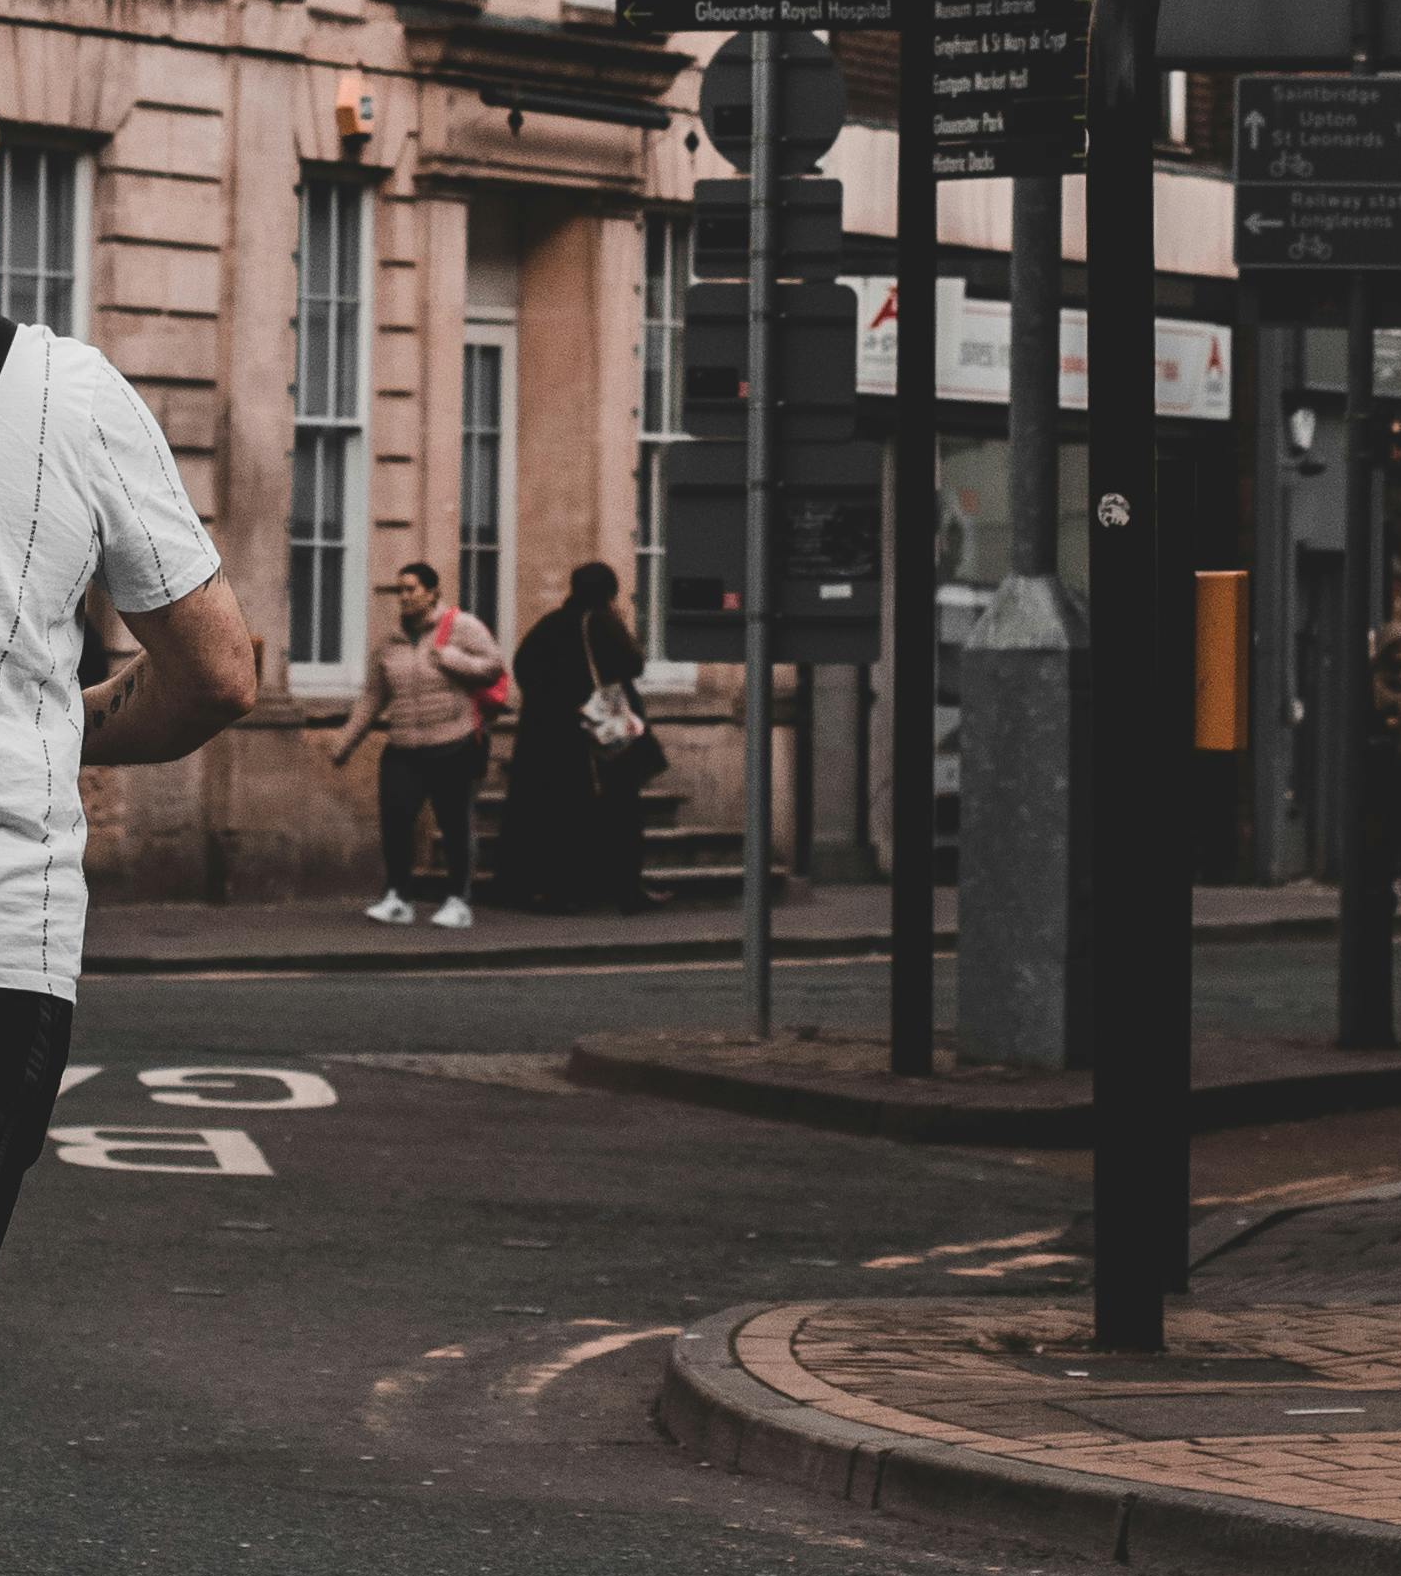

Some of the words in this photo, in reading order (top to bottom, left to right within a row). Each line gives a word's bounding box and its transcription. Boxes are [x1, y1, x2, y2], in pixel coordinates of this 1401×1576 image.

[695, 0, 776, 22] Gloucester
[780, 0, 823, 24] Royal
[1271, 84, 1381, 106] Saintbridge
[1299, 111, 1358, 129] Upton
[1271, 129, 1292, 147] St
[1299, 129, 1385, 149] Leonards
[1290, 191, 1362, 211] Railway
[1289, 213, 1394, 233] Longlevens
